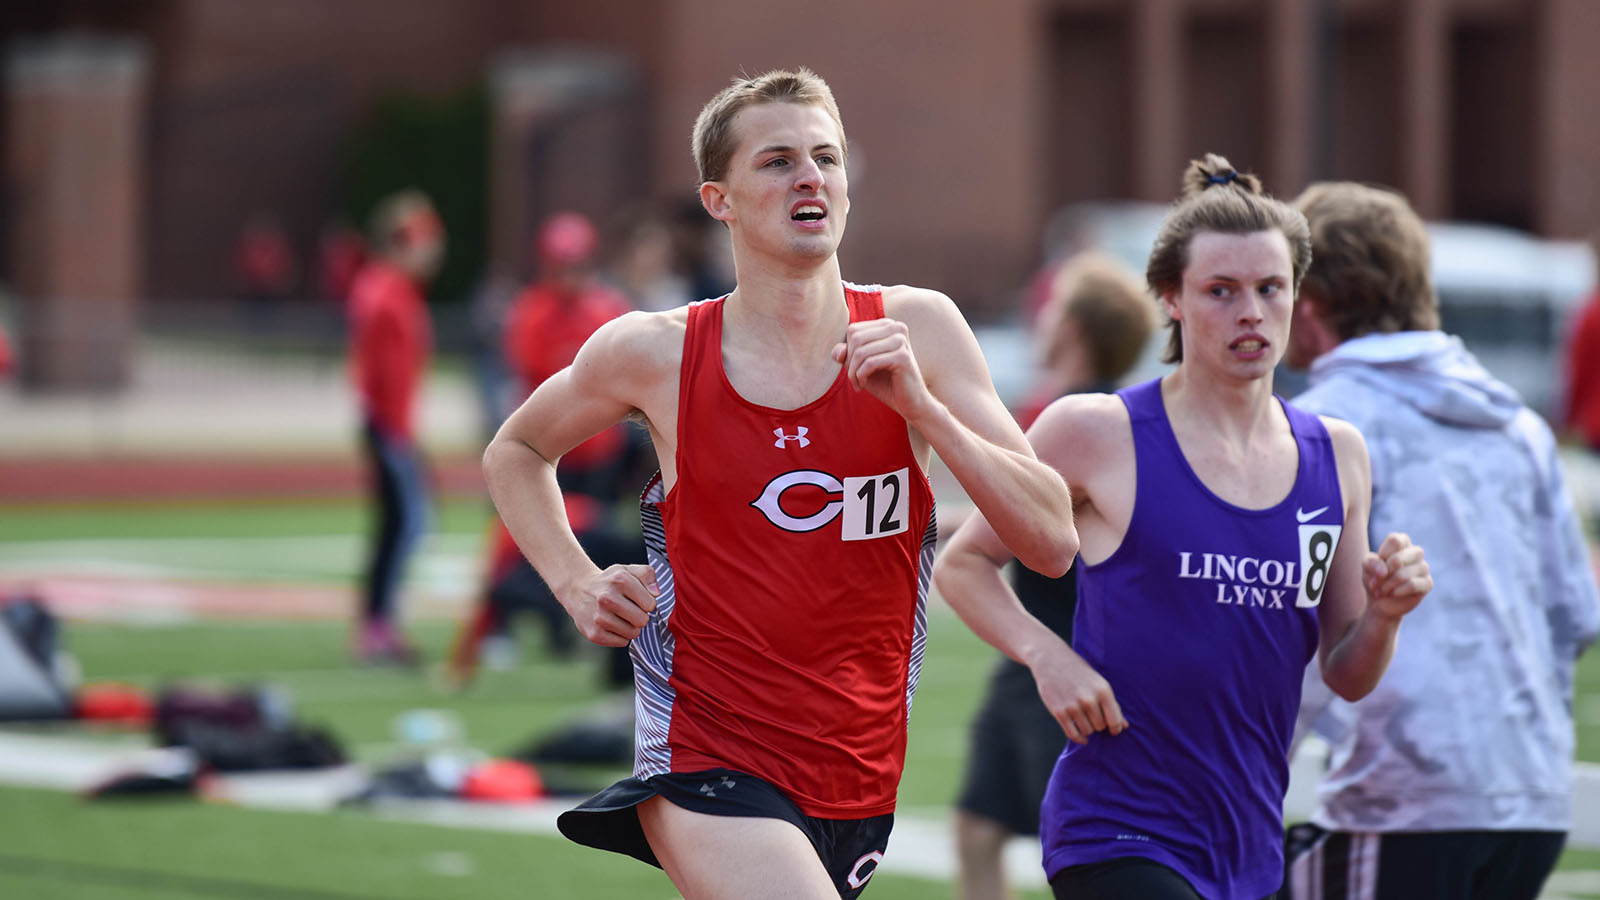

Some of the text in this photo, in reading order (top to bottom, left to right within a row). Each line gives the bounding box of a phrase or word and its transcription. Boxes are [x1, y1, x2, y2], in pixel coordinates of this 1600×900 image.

[749, 469, 844, 533] C
[856, 474, 901, 535] 12
[1216, 583, 1286, 610] LYNX
[1305, 530, 1333, 602] 8
